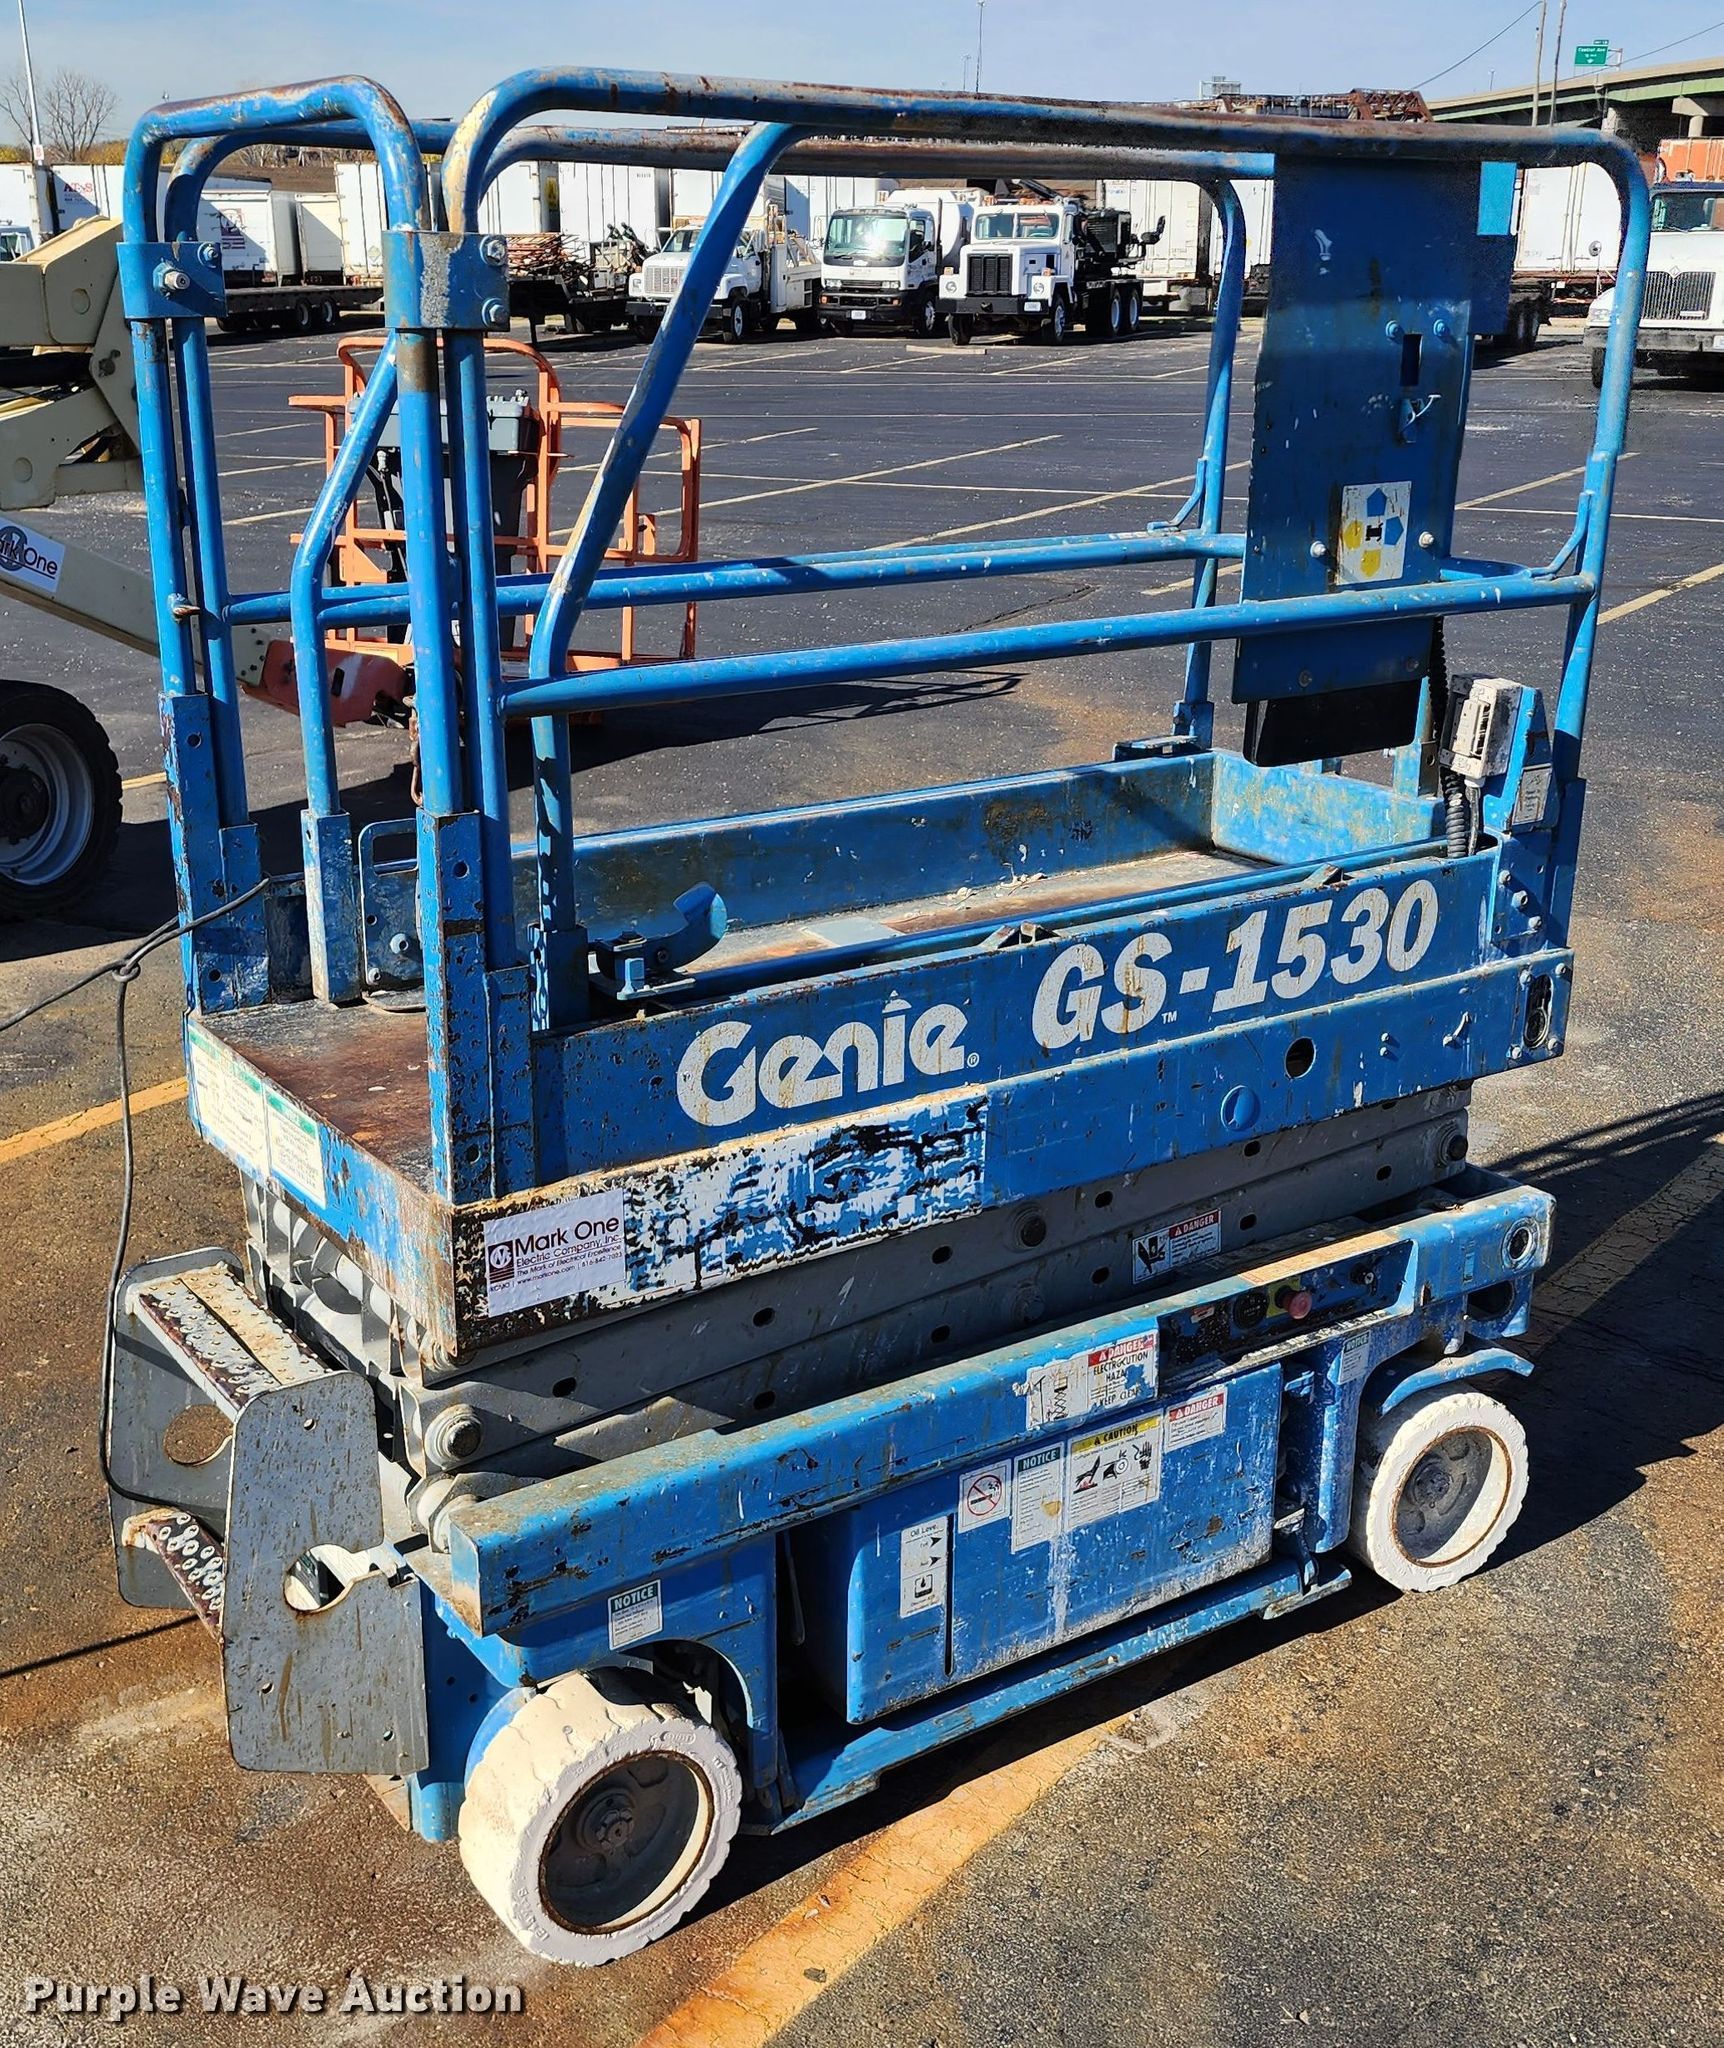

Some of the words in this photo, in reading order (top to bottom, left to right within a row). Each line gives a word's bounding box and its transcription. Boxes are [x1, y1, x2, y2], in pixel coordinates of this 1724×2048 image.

[24, 548, 57, 575] One
[1031, 879, 1439, 1050] GS-1530
[1183, 1214, 1215, 1233] DANGER
[515, 1228, 568, 1257] Mark
[574, 1217, 620, 1240] One
[516, 1252, 551, 1268] Electric
[553, 1239, 603, 1257] Company,
[517, 1269, 528, 1277] The
[530, 1263, 546, 1273] Mark
[517, 1265, 576, 1285] www.markone.com
[1107, 1337, 1145, 1359] DANGER
[1346, 1333, 1368, 1351] NOTICE
[1093, 1351, 1149, 1376] ELECTROCUTION
[1100, 1393, 1117, 1406] KEEP
[1184, 1396, 1219, 1416] DANGER
[1103, 1423, 1139, 1440] CAUTION
[1022, 1449, 1057, 1470] NOTICE
[911, 1528, 920, 1538] Oil
[614, 1585, 654, 1611] NOTICE
